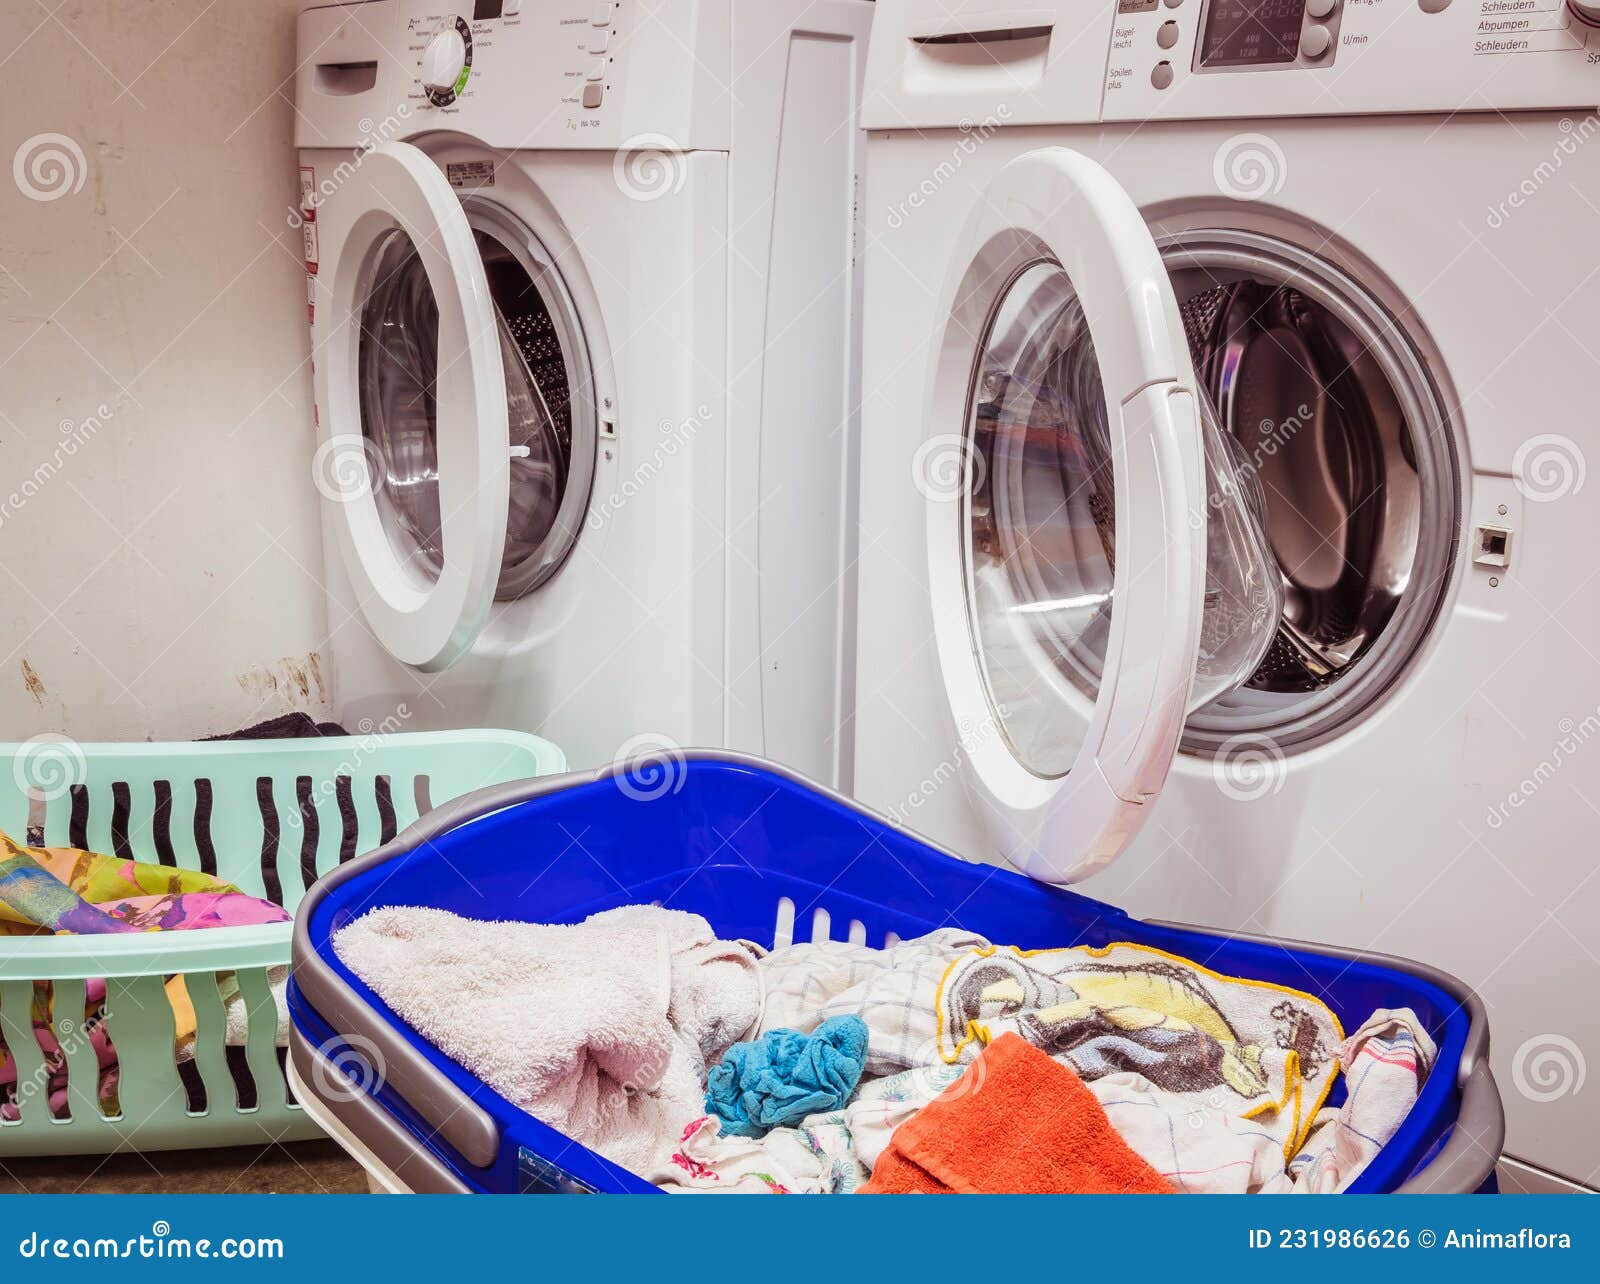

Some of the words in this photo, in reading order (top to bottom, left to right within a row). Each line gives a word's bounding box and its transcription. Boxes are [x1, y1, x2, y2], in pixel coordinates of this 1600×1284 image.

[1481, 0, 1535, 12] Schleudern
[1477, 19, 1529, 32] Abpumpen
[1343, 34, 1368, 45] U/min
[1474, 40, 1528, 52] Schleudern
